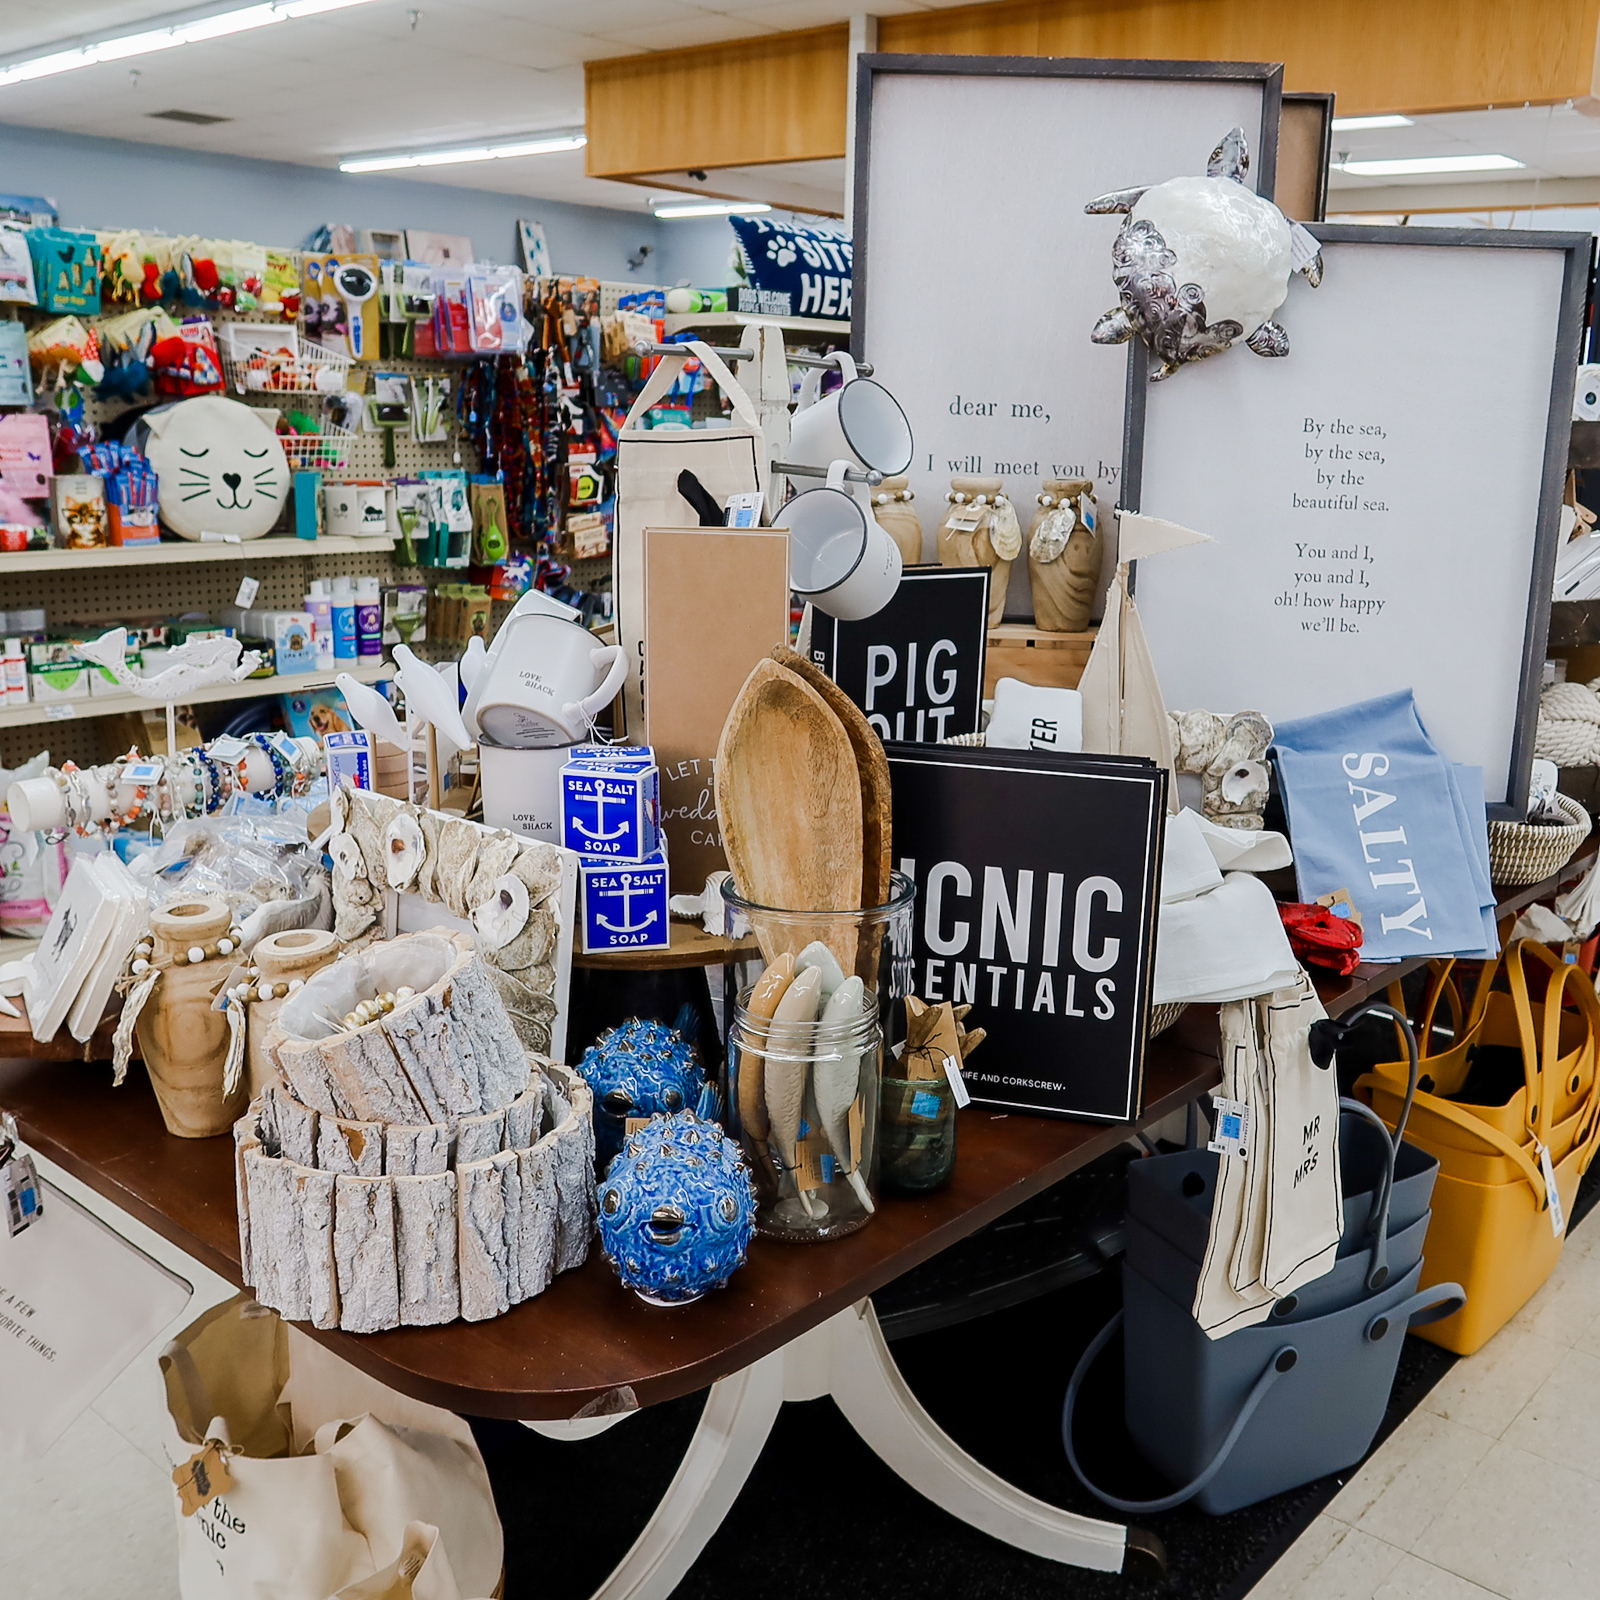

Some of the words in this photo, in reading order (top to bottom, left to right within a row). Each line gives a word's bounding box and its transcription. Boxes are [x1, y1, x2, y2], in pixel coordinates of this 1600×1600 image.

[799, 273, 853, 317] HER
[949, 395, 998, 417] dear
[1010, 402, 1051, 424] me,
[1302, 417, 1326, 440] By
[1330, 418, 1355, 435] the
[1359, 424, 1388, 440] sea,
[1305, 442, 1325, 465] by
[1329, 443, 1354, 460] the
[1357, 449, 1386, 465] sea,
[926, 453, 936, 473] I
[947, 455, 983, 474] will
[993, 460, 1041, 476] meet
[1052, 463, 1087, 479] you
[1097, 459, 1122, 485] by
[1316, 467, 1336, 490] by
[1340, 469, 1366, 486] the
[1292, 492, 1359, 511] beautiful
[1362, 500, 1390, 512] sea.
[1294, 542, 1326, 559] You
[1331, 544, 1359, 560] and
[1363, 545, 1375, 565] I,
[1294, 572, 1323, 588] you
[1327, 568, 1354, 584] and
[1359, 569, 1371, 589] I,
[1273, 590, 1299, 607] oh!
[1303, 591, 1335, 608] how
[1339, 593, 1386, 616] happy
[1301, 616, 1335, 632] we'll
[1340, 617, 1360, 634] be.
[518, 670, 543, 682] LOVE
[865, 638, 958, 711] PIG
[524, 680, 556, 697] SHACK
[665, 758, 701, 782] LET
[567, 780, 593, 793] SEA
[606, 783, 635, 796] SALT
[512, 813, 536, 822] LOVE
[522, 821, 553, 830] SHACK
[584, 840, 621, 853] SOAP
[1341, 752, 1433, 941] SALTY
[591, 877, 618, 889] SEA
[633, 873, 663, 887] SALT
[900, 857, 1124, 973] ICNIC
[609, 933, 649, 946] SOAP
[960, 1071, 979, 1081] NIFE
[980, 1073, 1000, 1084] AND
[1302, 1115, 1320, 1146] MR
[1293, 1151, 1319, 1190] MRS
[4, 1295, 16, 1304] A
[14, 1300, 37, 1318] FEW
[213, 1496, 246, 1535] the
